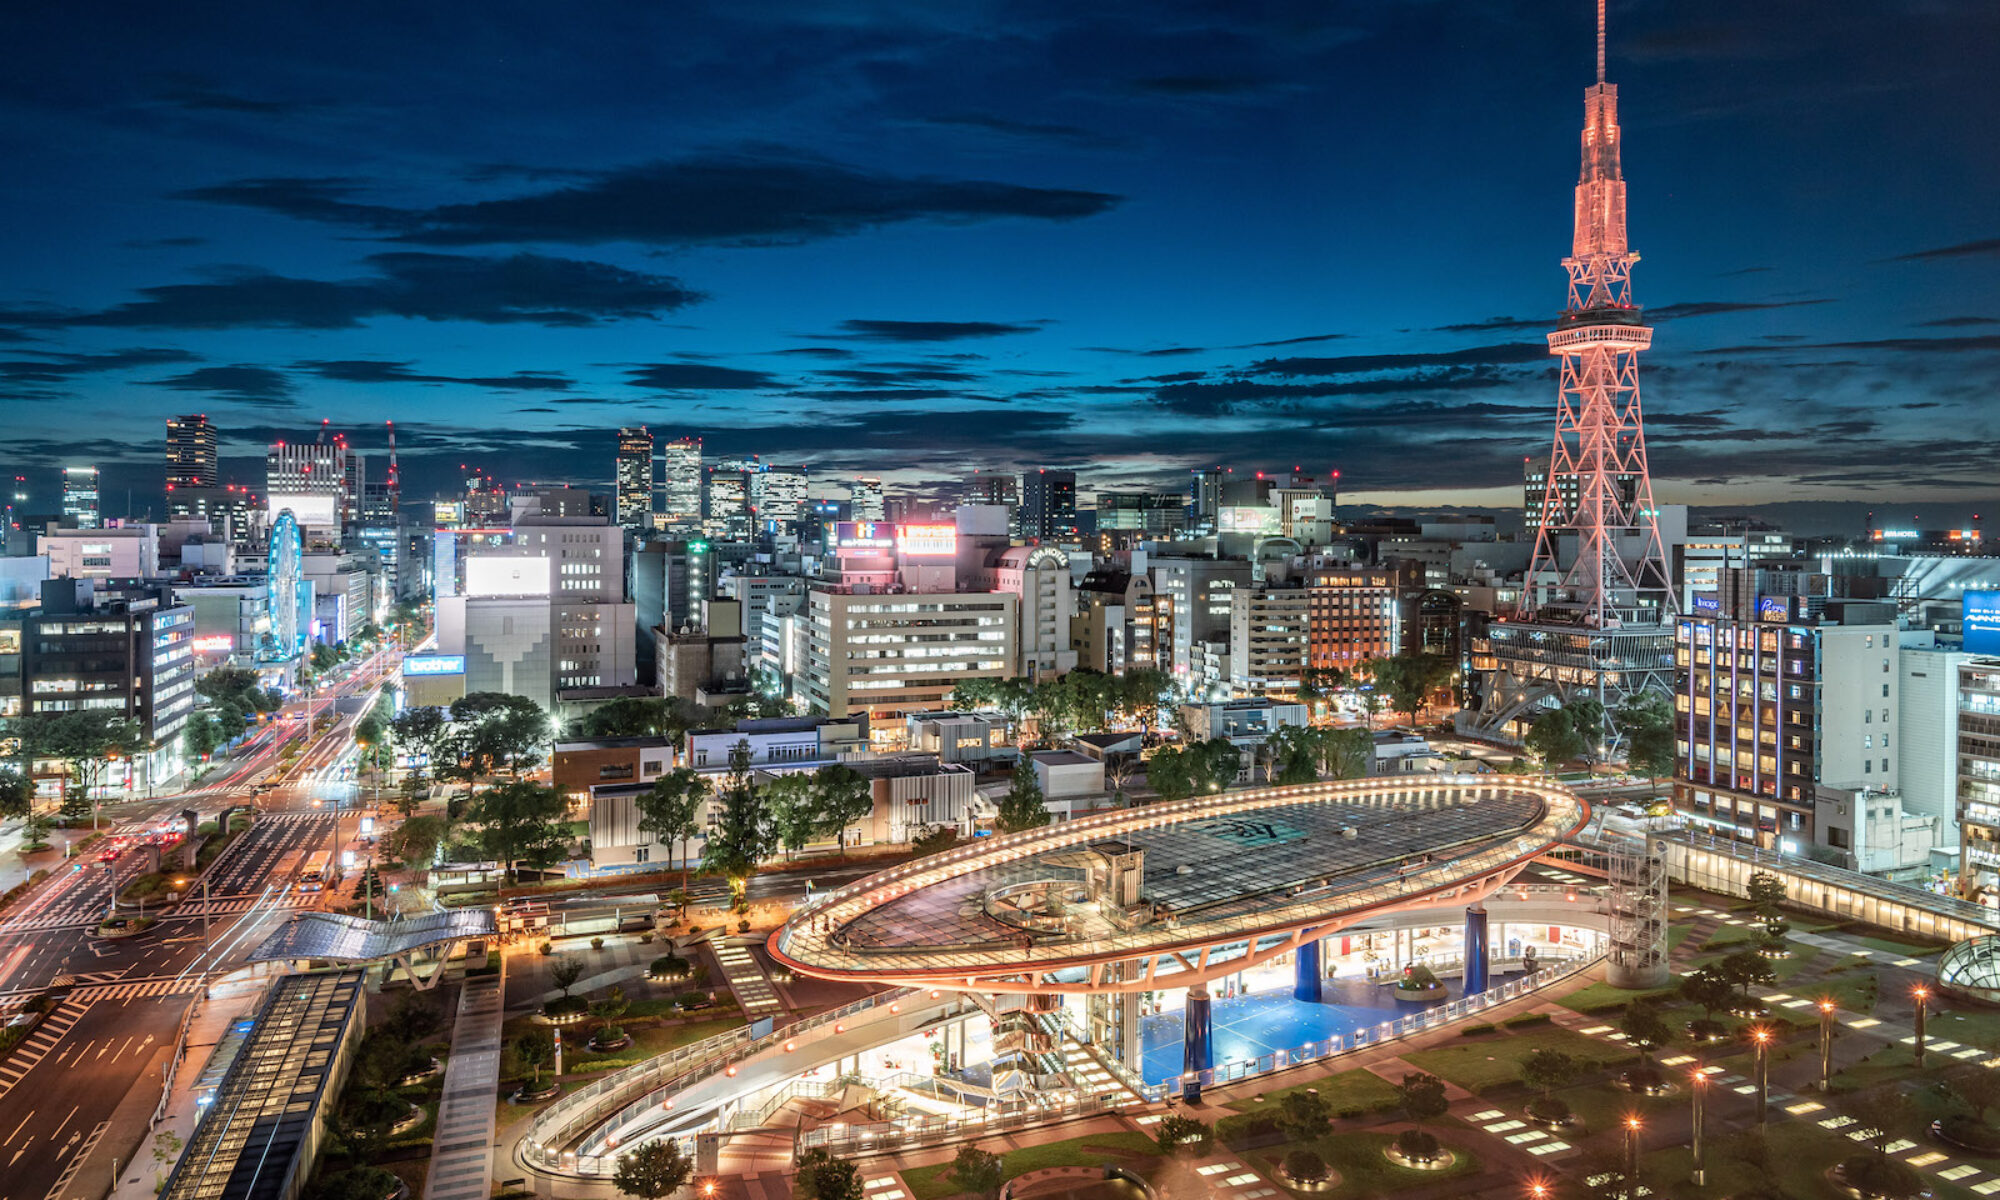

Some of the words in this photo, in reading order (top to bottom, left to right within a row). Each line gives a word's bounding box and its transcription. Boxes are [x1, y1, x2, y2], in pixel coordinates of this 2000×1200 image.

[1896, 530, 1919, 538] HOTEL
[1030, 549, 1045, 566] APA
[1045, 548, 1068, 566] HOTEL
[410, 659, 459, 672] brother
